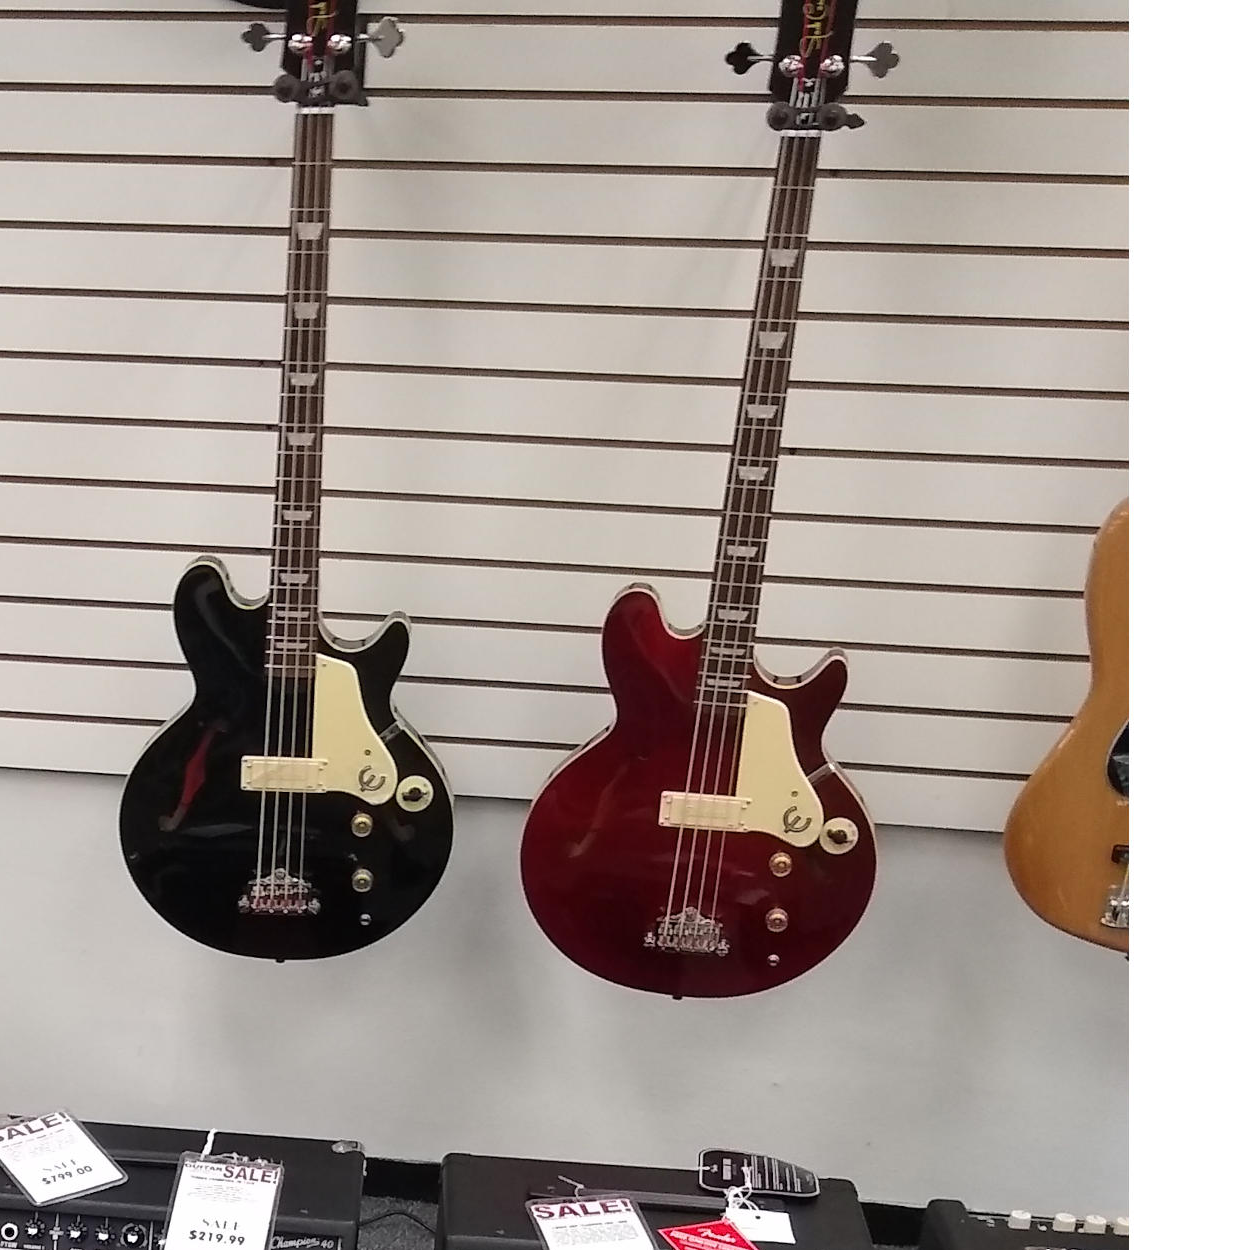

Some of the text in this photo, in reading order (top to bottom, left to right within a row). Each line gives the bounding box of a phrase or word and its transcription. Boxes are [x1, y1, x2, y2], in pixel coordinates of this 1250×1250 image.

[42, 1165, 92, 1185] $79900
[223, 1165, 279, 1185] SALE!
[534, 1199, 632, 1220] SALE!
[188, 1230, 246, 1246] $219.99
[270, 1236, 334, 1249] Champion 40
